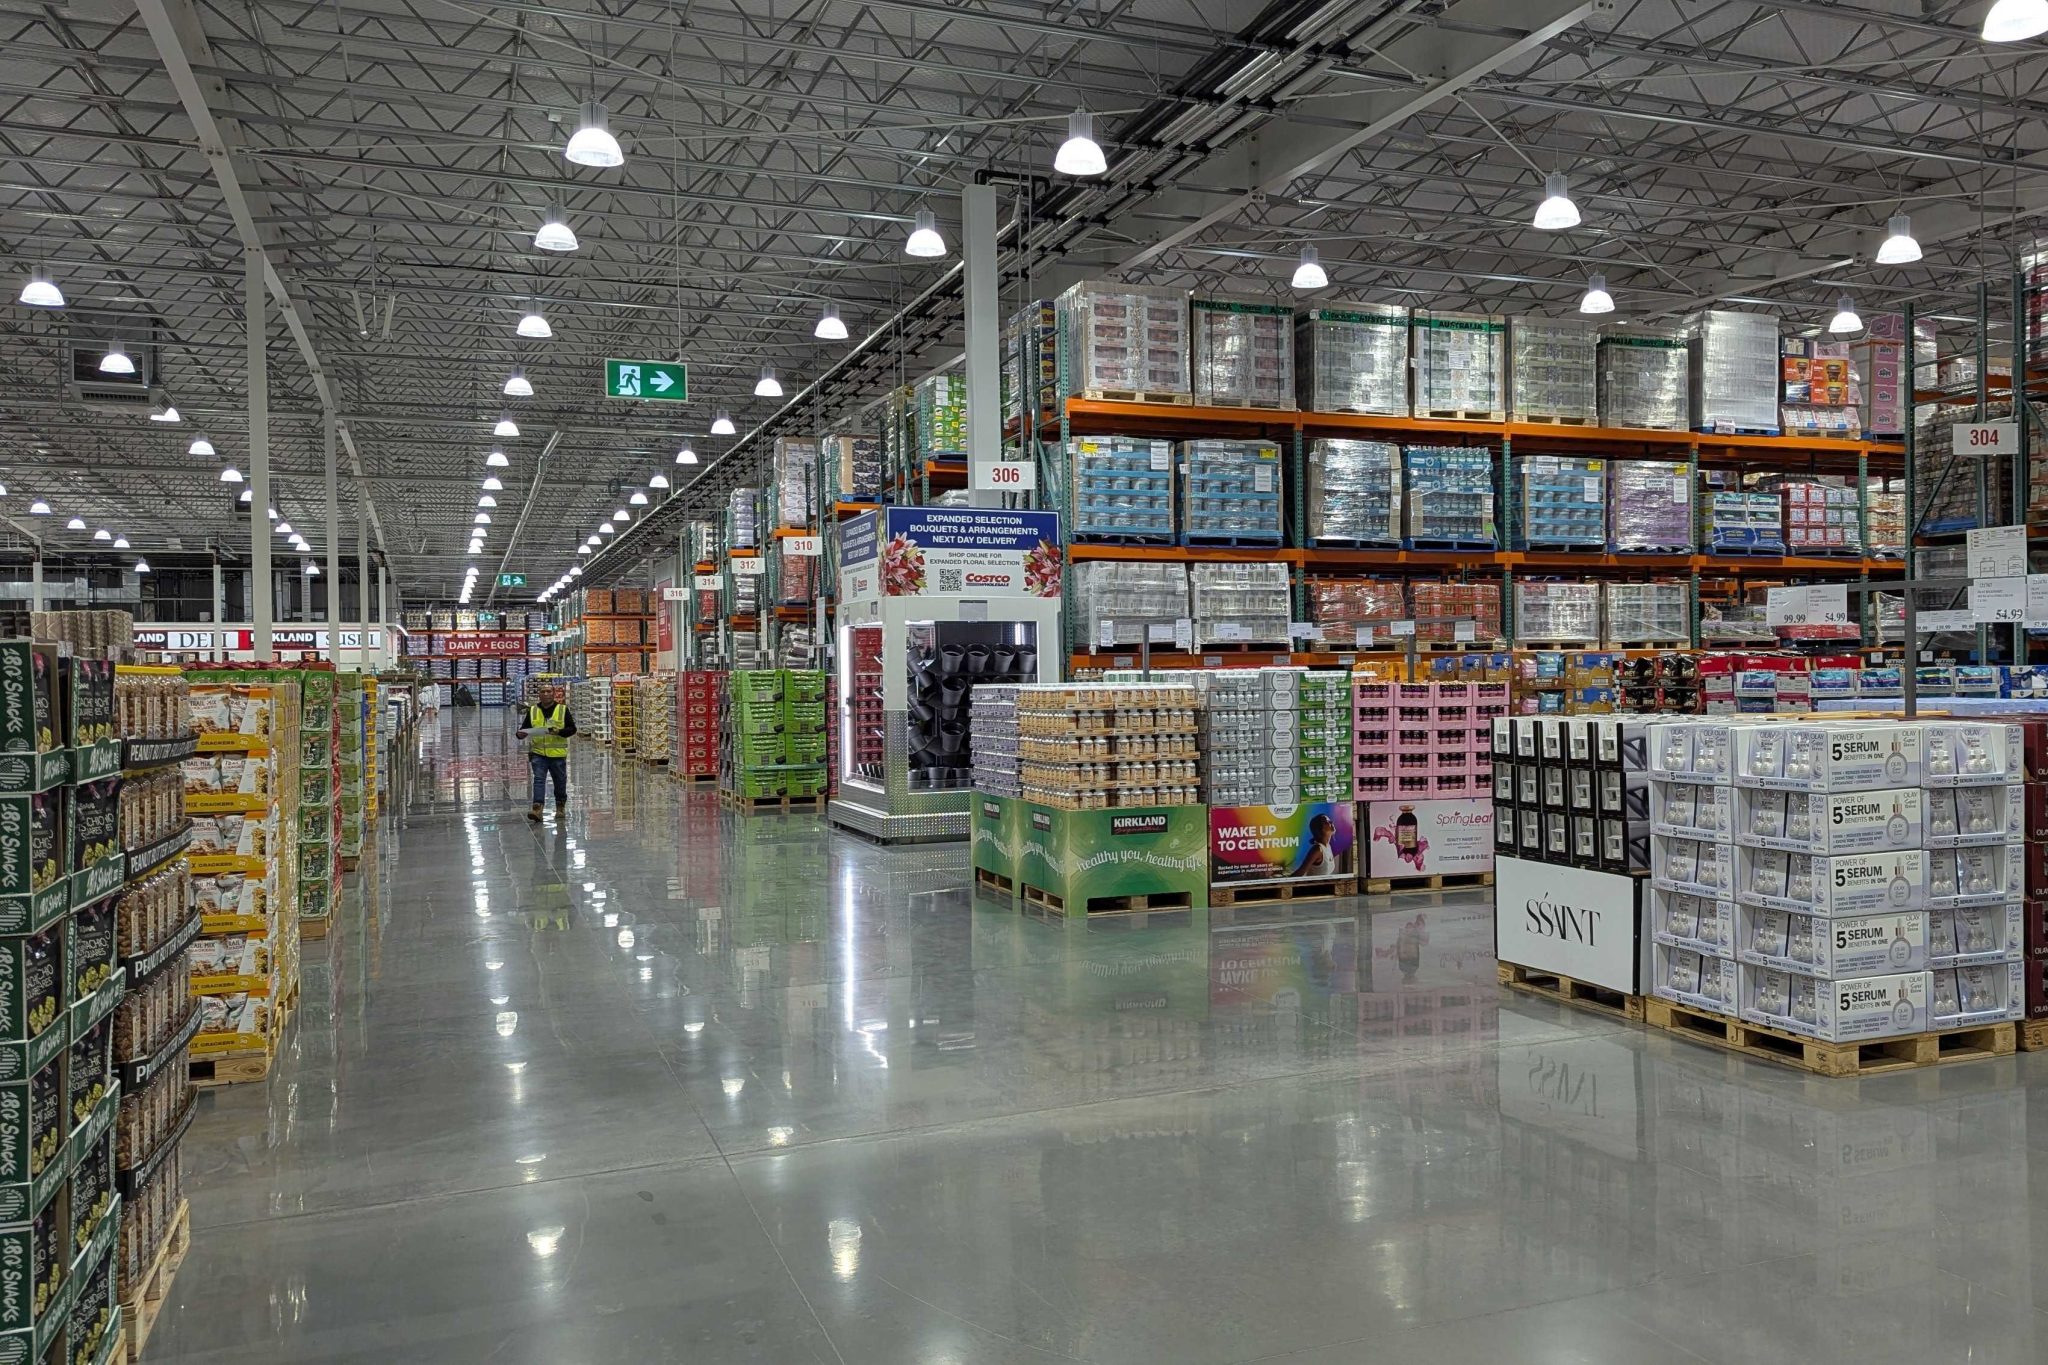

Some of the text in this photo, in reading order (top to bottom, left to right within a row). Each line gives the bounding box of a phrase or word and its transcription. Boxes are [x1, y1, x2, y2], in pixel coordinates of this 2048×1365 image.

[1439, 321, 1482, 330] AUSTRALIA
[1970, 430, 1999, 446] 304
[992, 468, 1020, 482] 306
[927, 514, 1022, 525] EXPANDED SELECTION
[910, 525, 958, 533] BOUQUETS
[968, 526, 1038, 535] ARRANGEMENTS
[794, 541, 813, 550] 310
[932, 536, 1018, 545] NEXT DAY DELIVERY
[740, 561, 755, 569] 312
[702, 578, 715, 586] 314
[1784, 614, 1806, 623] 99.99
[1825, 612, 1846, 622] 54.99
[1996, 609, 2023, 620] 54.99
[449, 640, 520, 650] DAIRY EGGS
[3, 680, 24, 734] SNACKS
[1833, 734, 1854, 742] POWER
[130, 744, 154, 761] PEANUT
[1832, 741, 1879, 761] 5 SERUM
[1834, 797, 1855, 805] POWER
[1436, 812, 1494, 826] SpringLeaf
[1833, 804, 1880, 824] 5 SERUM
[1114, 817, 1166, 827] KIRKLAND
[1218, 825, 1277, 839] WAKE UP
[1218, 837, 1300, 852] TO CENTRUM
[1, 836, 20, 888] SNACKS
[131, 852, 153, 875] PEANUT
[1077, 851, 1119, 873] healthy
[1121, 850, 1144, 863] you,
[1144, 851, 1184, 873] healthy
[1184, 856, 1204, 870] life
[1835, 866, 1883, 887] 5 SERUM
[1836, 927, 1883, 949] 5 SERUM
[135, 950, 160, 979] PEANUT
[1840, 989, 1887, 1011] 5 SERUM
[1, 1122, 20, 1176] SNACKS
[2, 1269, 23, 1324] SNACKS
